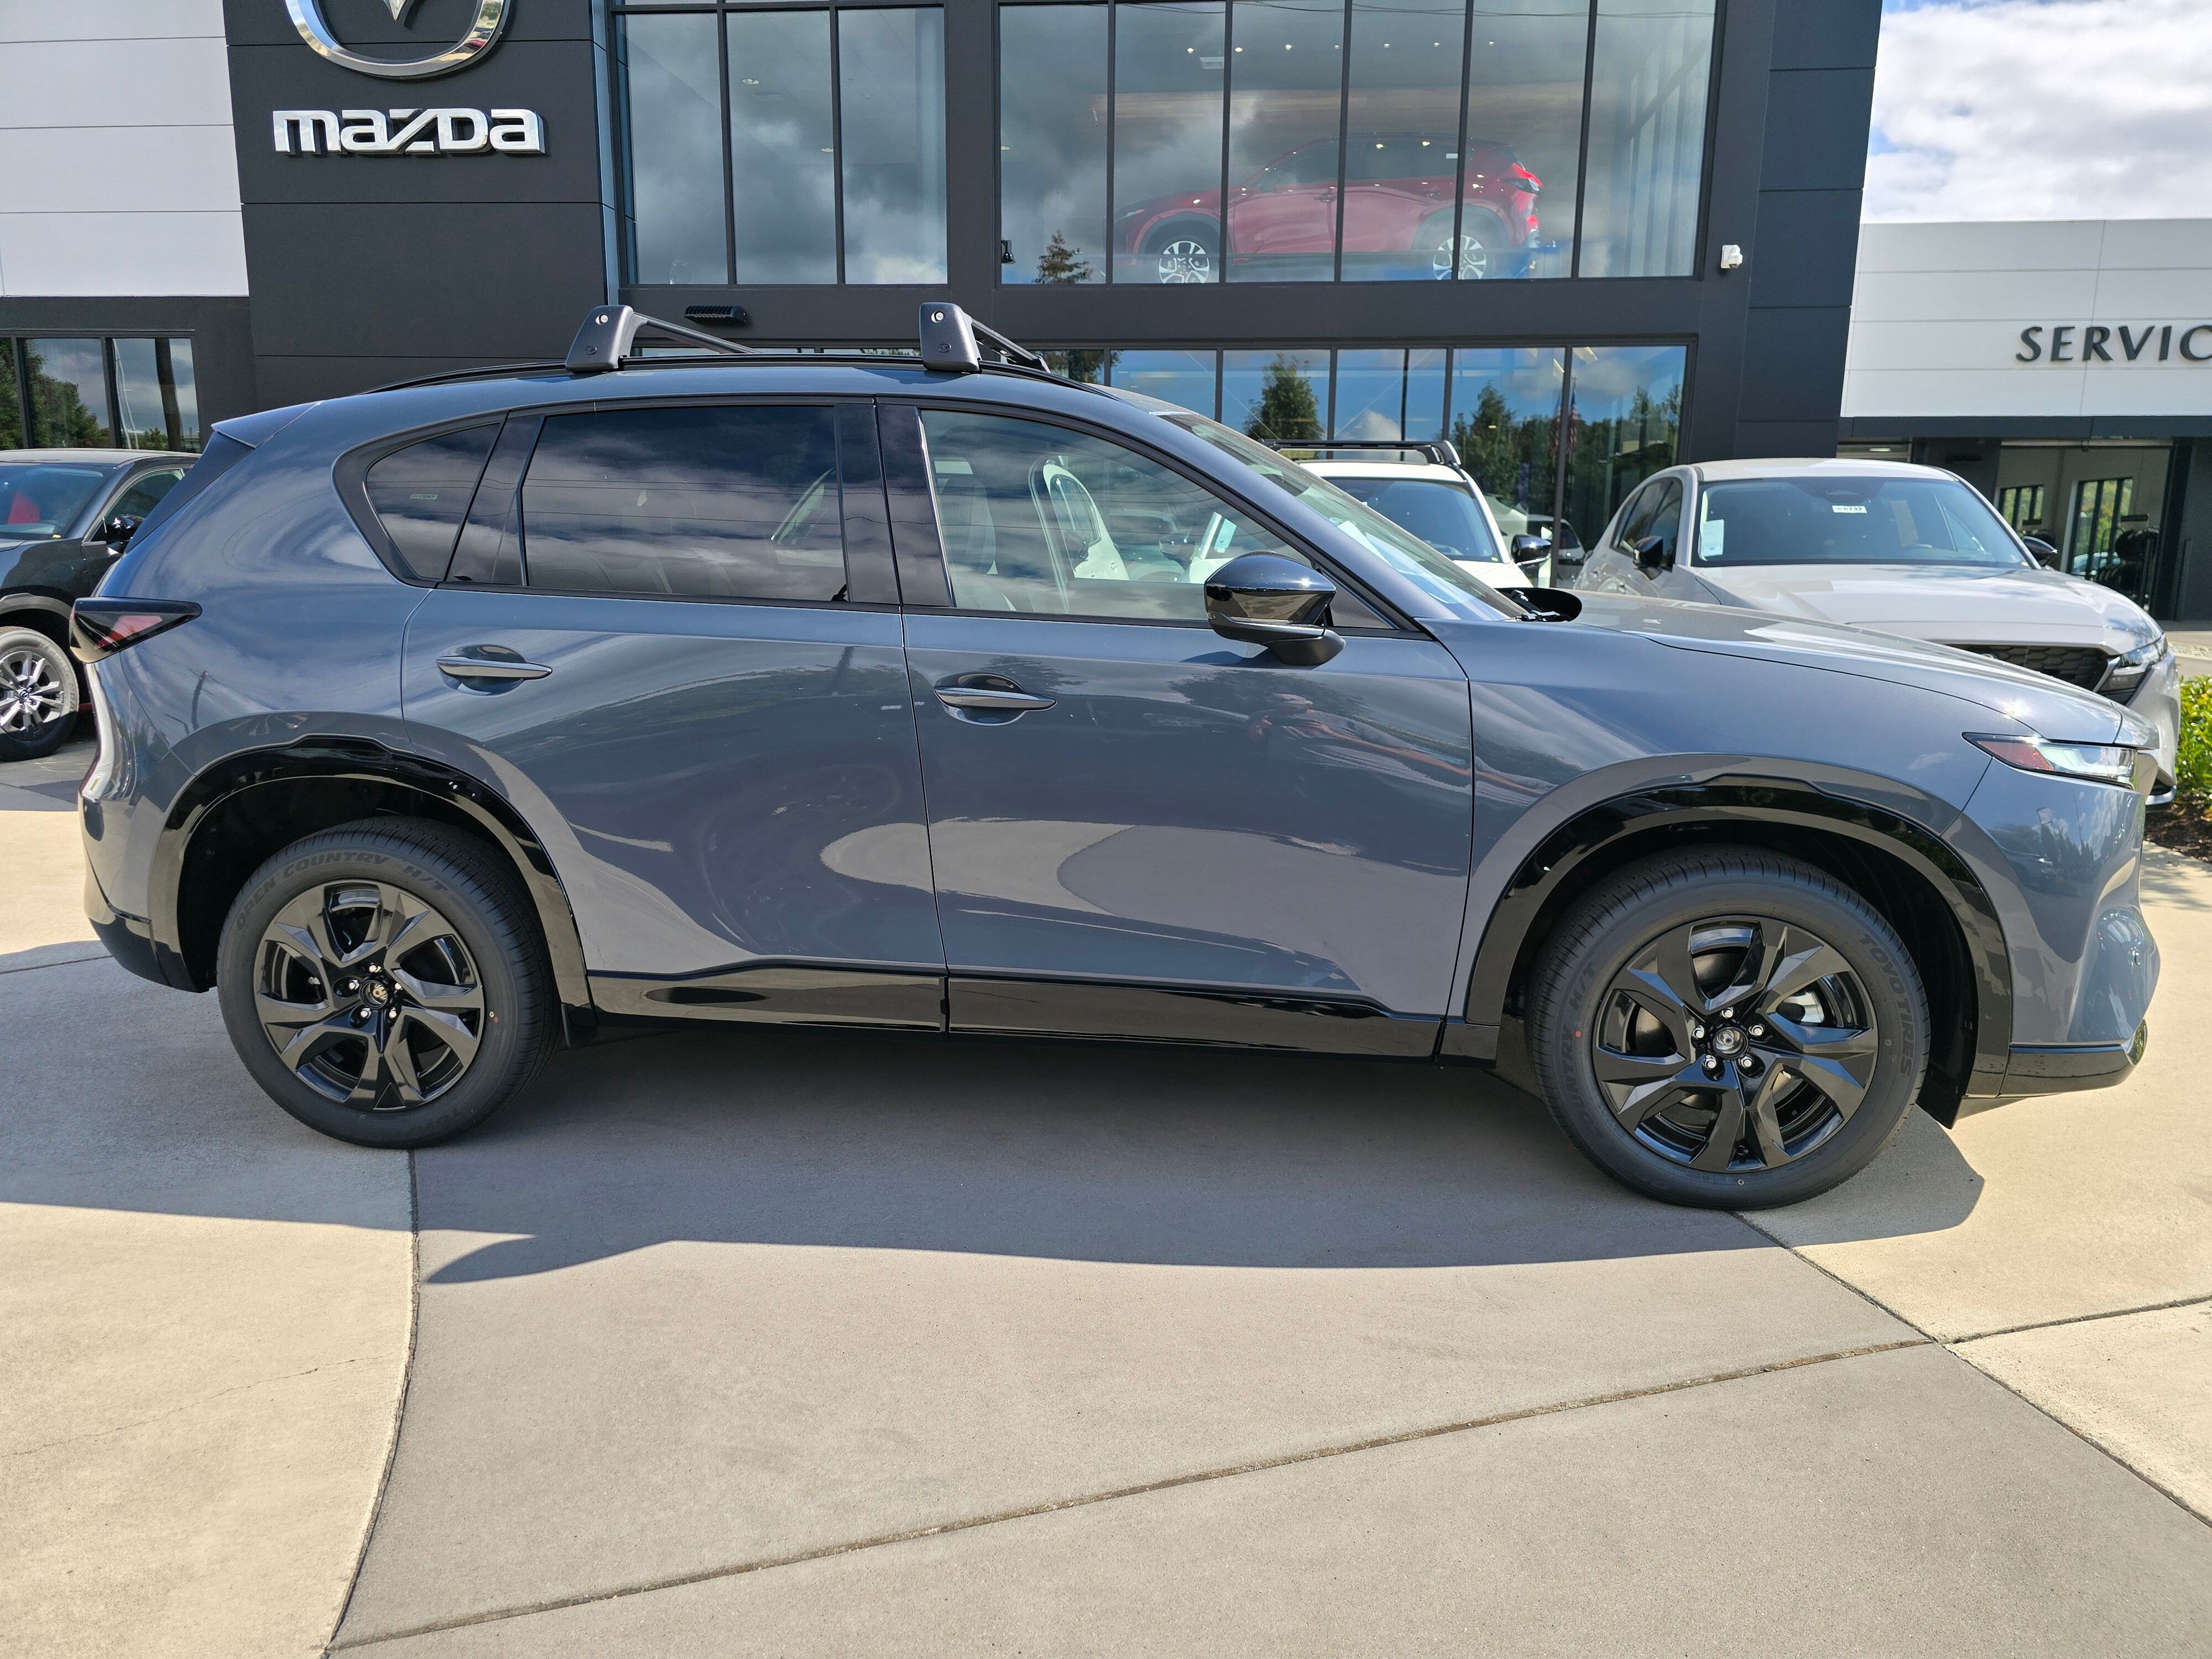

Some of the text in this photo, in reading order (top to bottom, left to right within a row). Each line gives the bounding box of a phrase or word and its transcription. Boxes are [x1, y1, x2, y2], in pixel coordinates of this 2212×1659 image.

[237, 849, 448, 931] OPEN COUNTRY H/T
[1569, 960, 1596, 1011] H/T
[1859, 932, 1916, 1077] TOYO TIRES
[1560, 1025, 1603, 1139] COUNTRY
